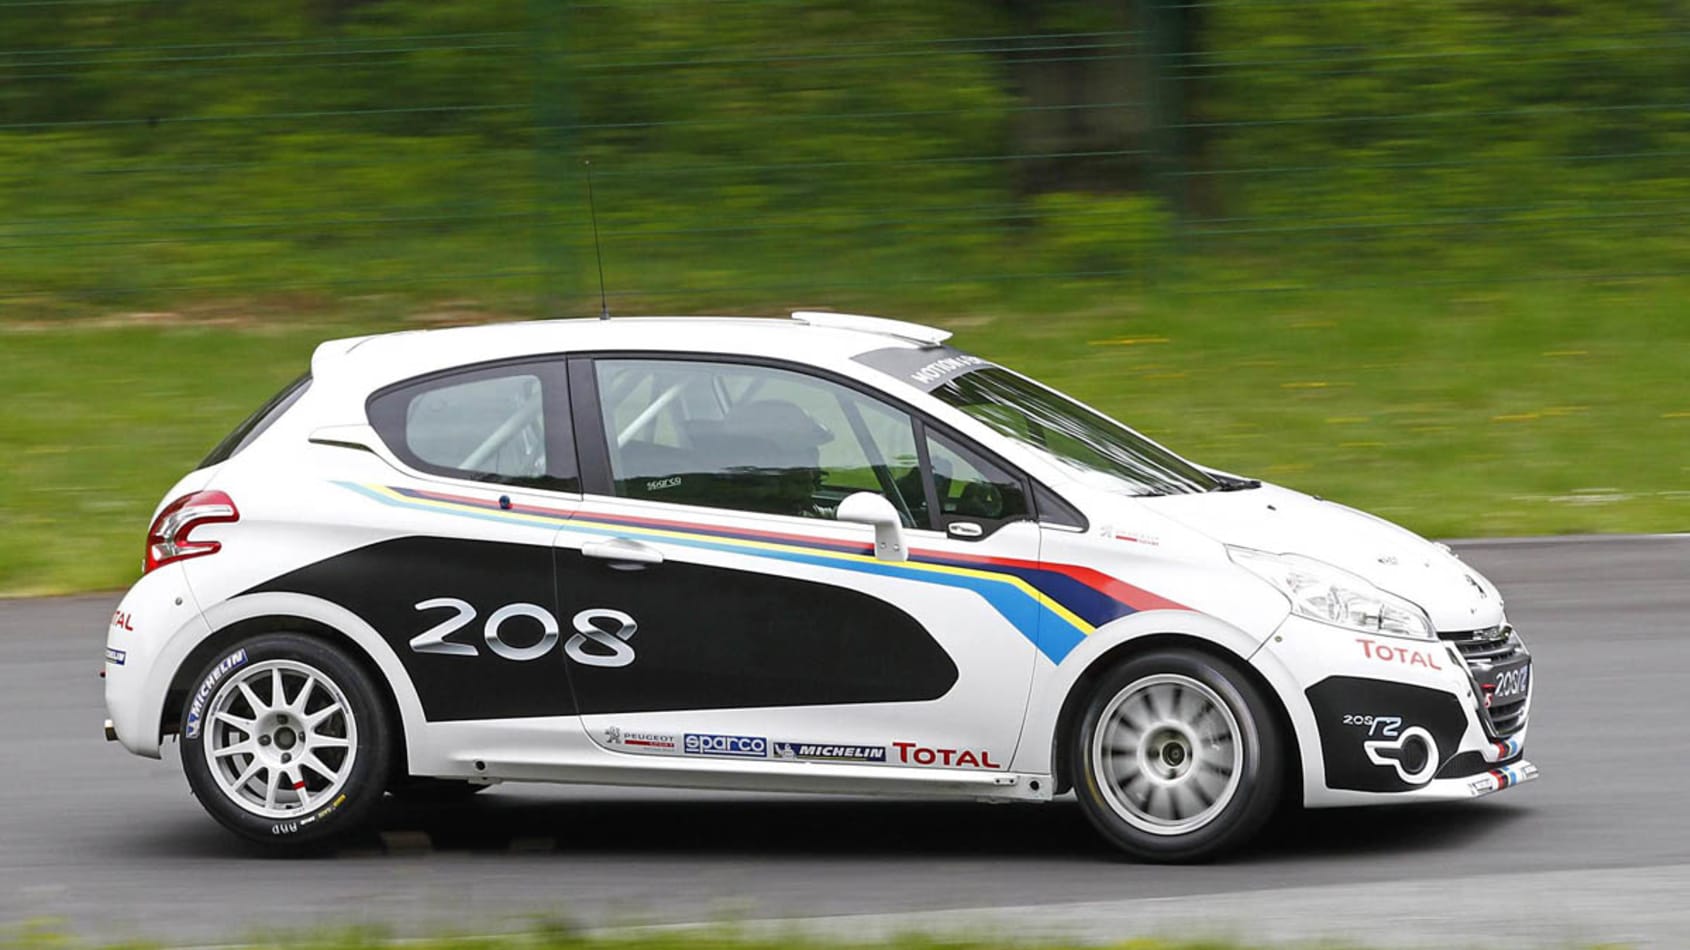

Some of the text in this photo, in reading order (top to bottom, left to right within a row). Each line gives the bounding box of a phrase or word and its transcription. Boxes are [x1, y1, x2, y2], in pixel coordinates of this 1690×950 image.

[409, 597, 638, 668] 208
[1356, 639, 1442, 671] TOTAL
[190, 649, 245, 717] MICHELIN
[624, 733, 675, 742] PEUGEOT
[685, 735, 765, 754] sparco
[799, 745, 884, 758] MICHELIN
[892, 742, 1000, 768] TOTAL
